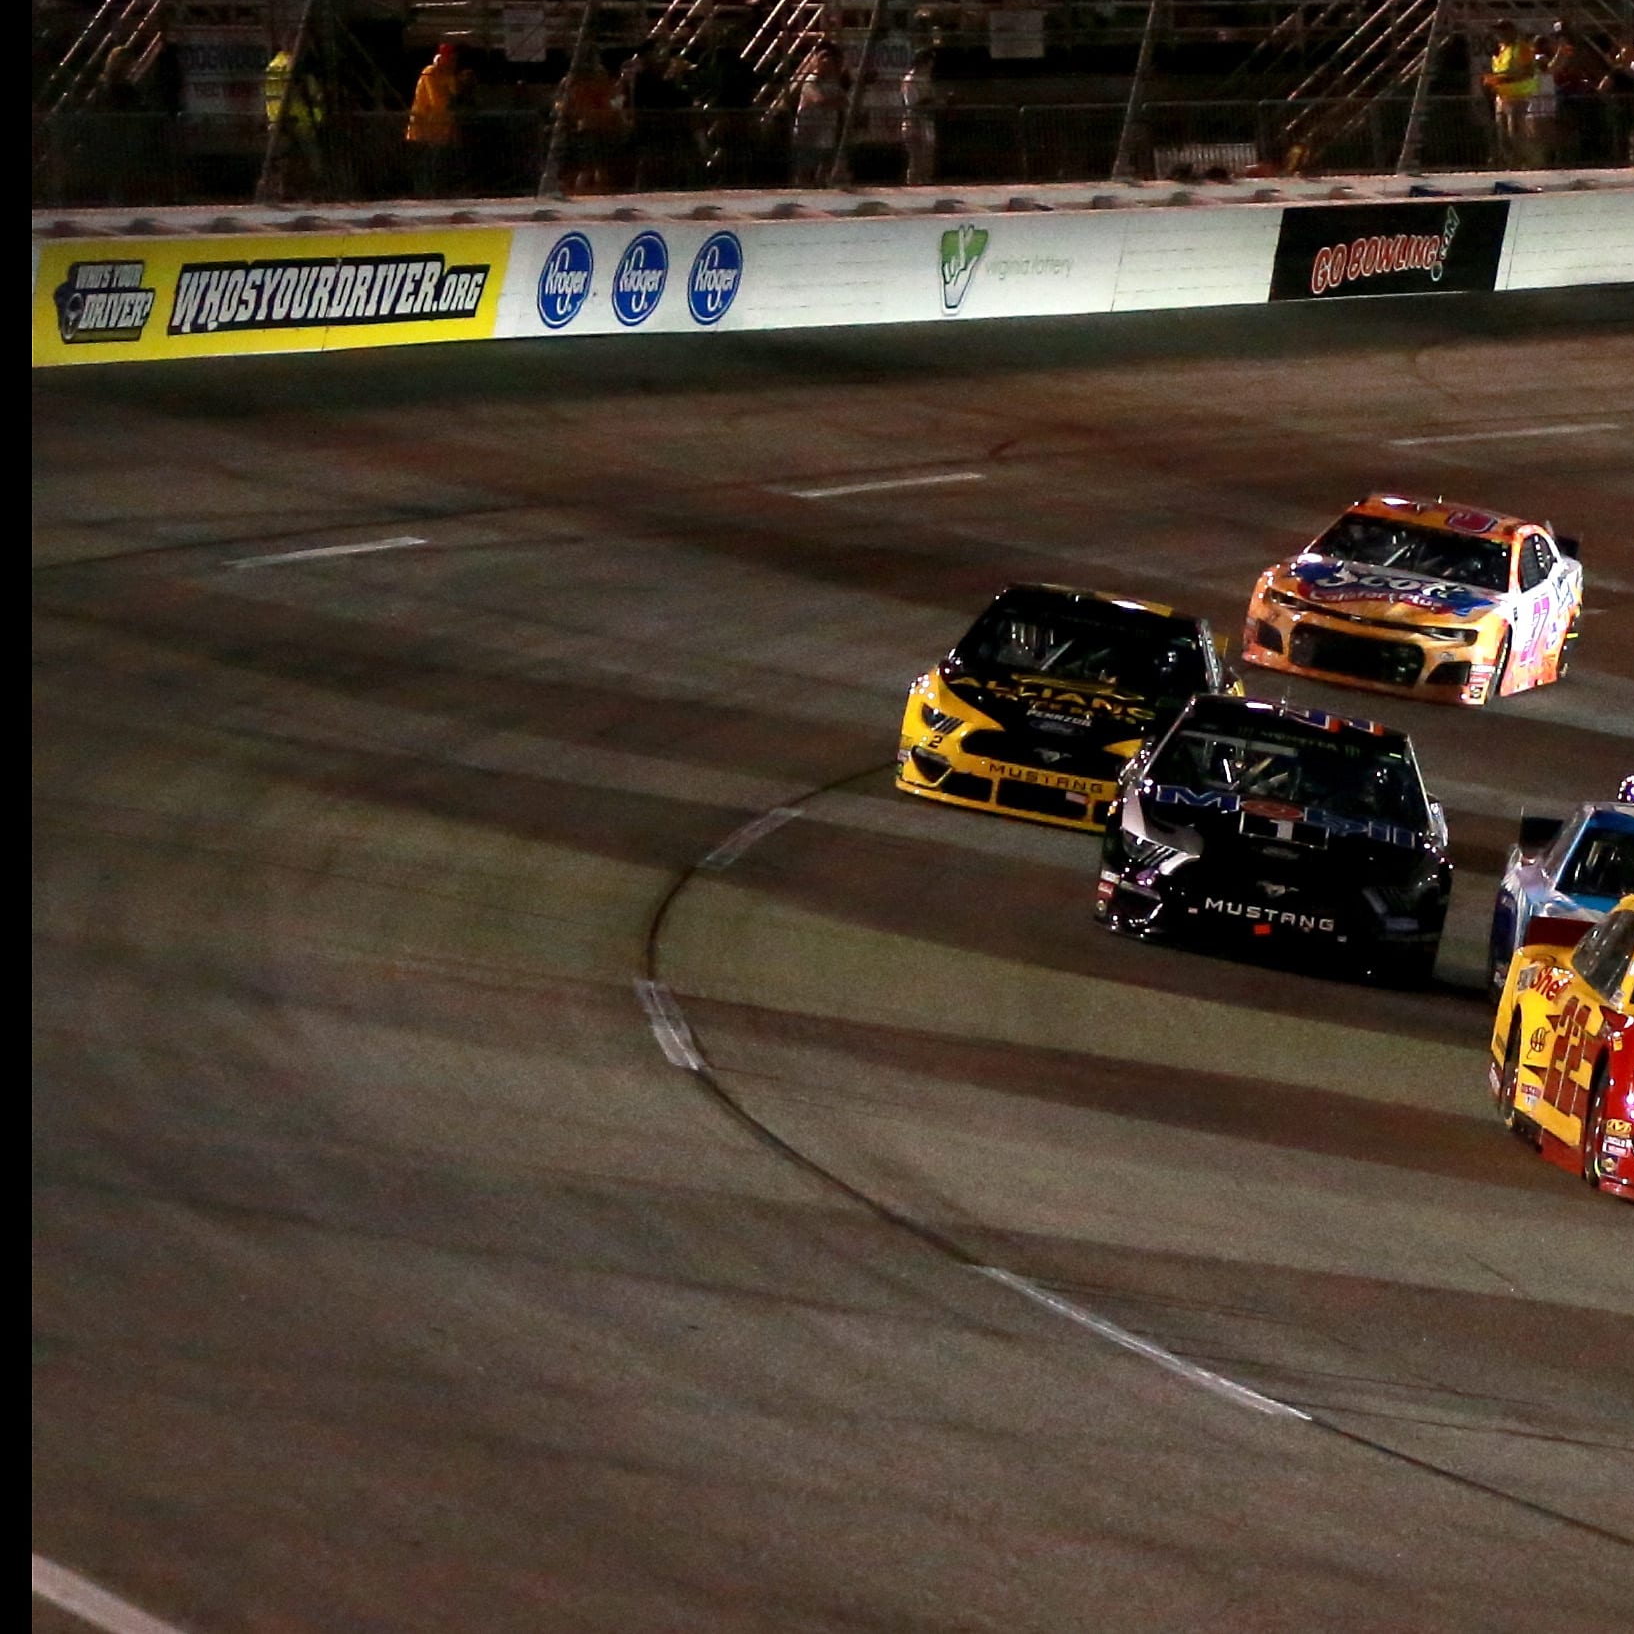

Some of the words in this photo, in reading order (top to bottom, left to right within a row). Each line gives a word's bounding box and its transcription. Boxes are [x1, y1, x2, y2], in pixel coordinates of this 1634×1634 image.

[170, 260, 487, 333] WHOSYOURDRIVER.ORG
[545, 246, 588, 315] Kroger
[618, 245, 664, 313] Kroger
[693, 245, 739, 313] Kroger
[1311, 242, 1348, 295] GO
[1347, 233, 1441, 281] BOWLING
[927, 733, 944, 749] 2
[988, 761, 1104, 795] MUSTANG
[1203, 896, 1335, 933] MUSTANG
